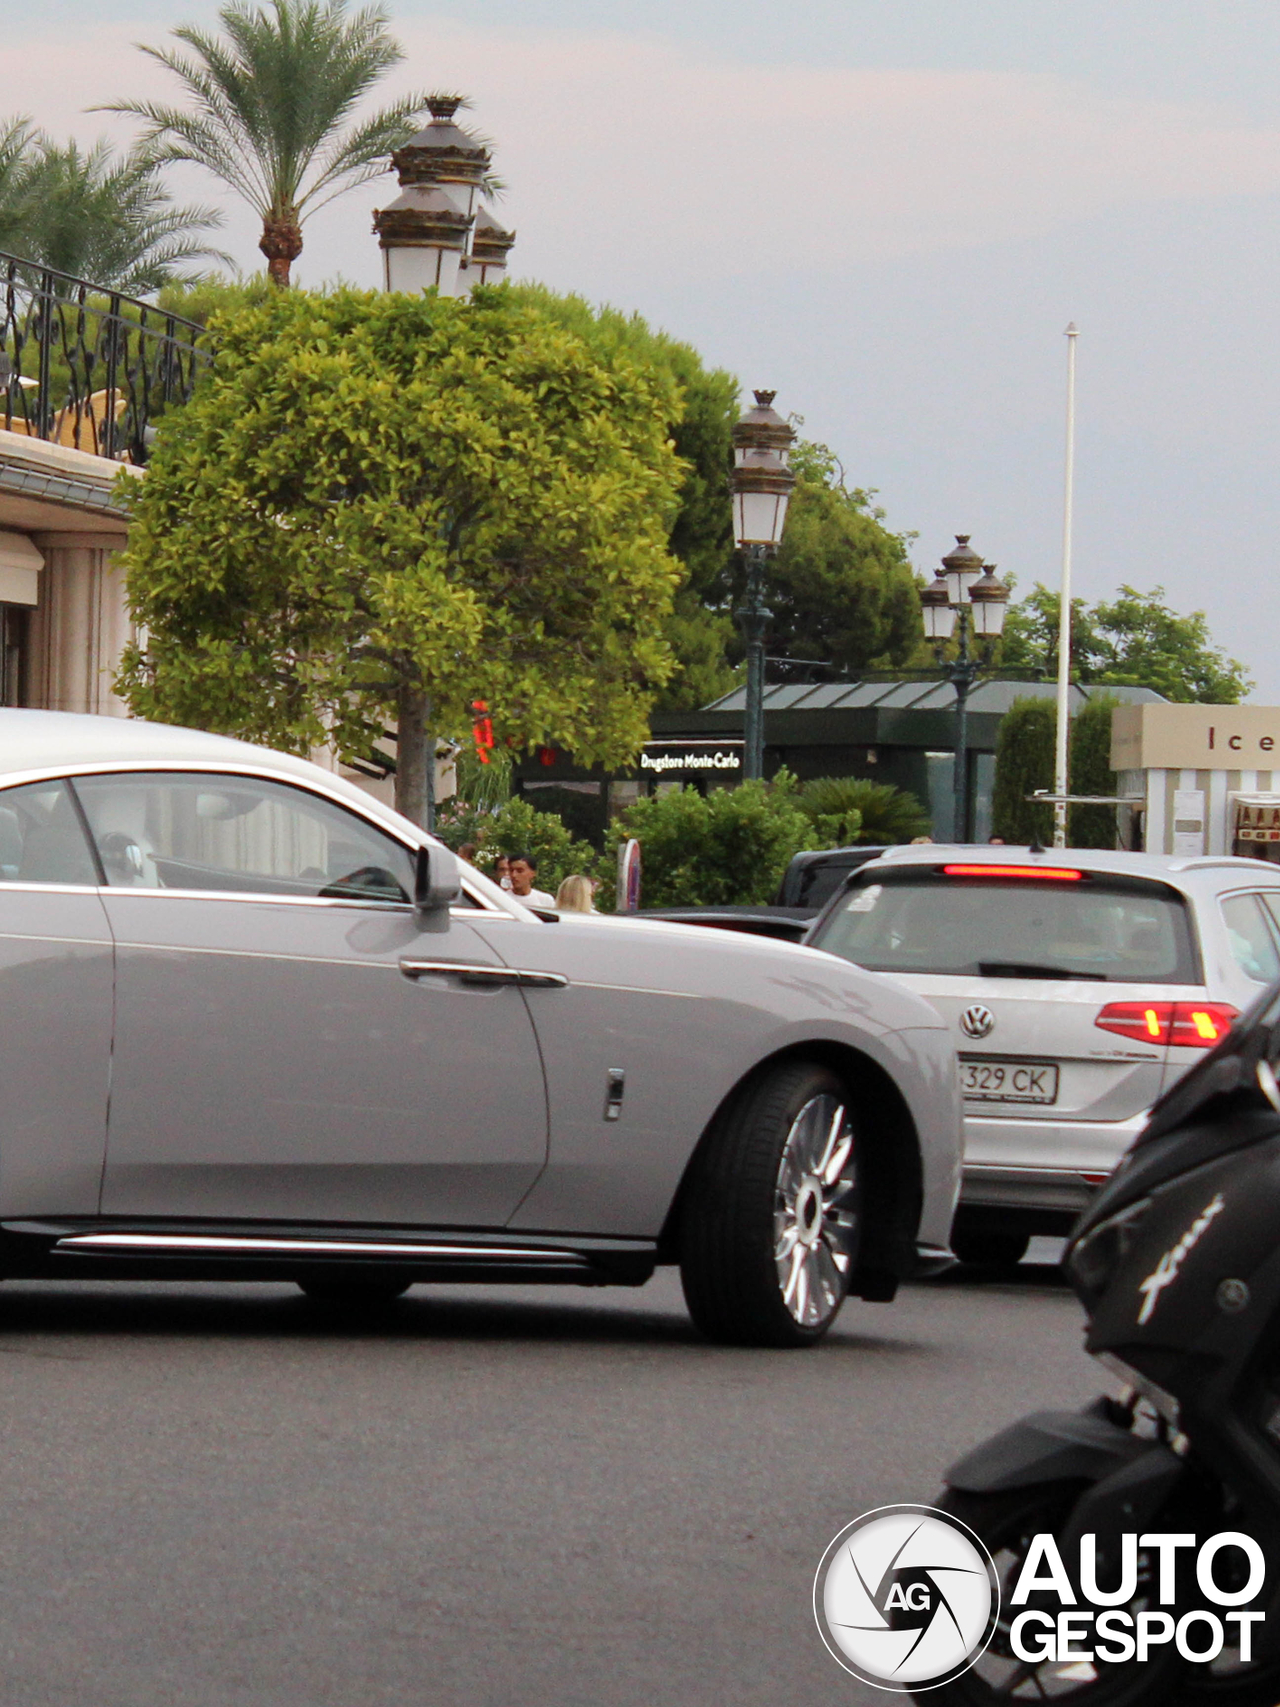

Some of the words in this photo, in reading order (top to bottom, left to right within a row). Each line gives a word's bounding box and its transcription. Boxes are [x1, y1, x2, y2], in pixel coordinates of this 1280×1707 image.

[1208, 726, 1275, 751] Ice
[640, 753, 684, 773] Drugstore
[959, 1065, 1005, 1090] 329
[1012, 1069, 1047, 1094] CK
